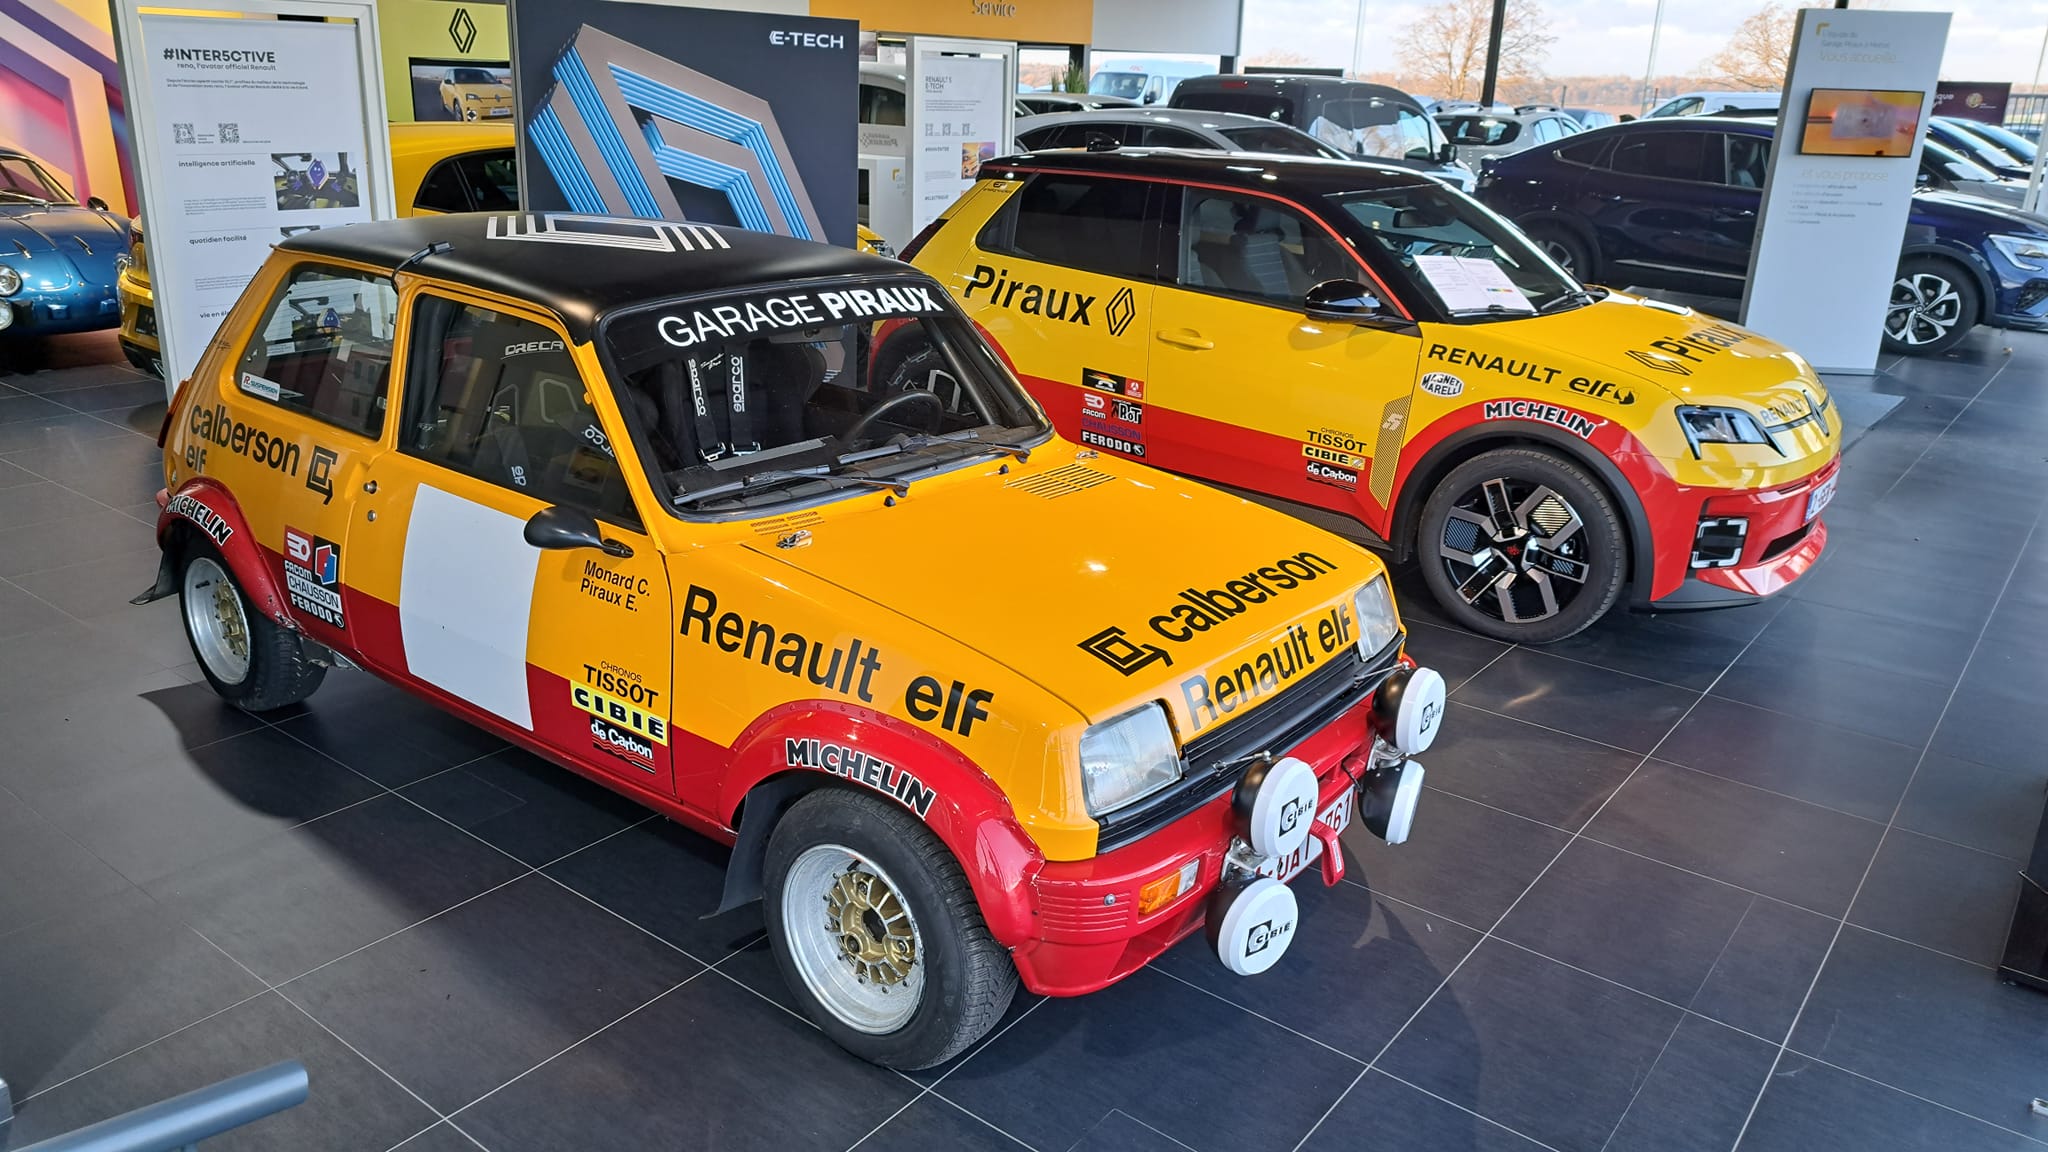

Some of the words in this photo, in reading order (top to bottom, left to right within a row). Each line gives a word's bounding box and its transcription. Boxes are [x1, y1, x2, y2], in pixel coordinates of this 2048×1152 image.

[973, 0, 1016, 17] Service
[163, 48, 276, 63] #INTER5CTIVE
[769, 29, 844, 49] E-TECH
[178, 160, 220, 168] intelligence
[189, 237, 222, 245] quotidien
[963, 264, 1097, 326] Piraux
[657, 295, 825, 347] GARAGE
[817, 287, 944, 320] PIRAUX
[1649, 324, 1752, 362] Piraux
[688, 358, 706, 417] sparco
[730, 355, 745, 412] sparco
[1427, 343, 1561, 384] RENAULT
[1568, 375, 1616, 398] elf
[1082, 418, 1142, 439] CHAUSSON
[1484, 401, 1596, 440] MICHELIN
[1760, 398, 1804, 425] RENAULT
[190, 403, 301, 477] calberson
[1082, 431, 1131, 453] FERODO
[1306, 430, 1368, 453] TISSOT
[1320, 427, 1354, 439] CHRONOS
[186, 444, 207, 473] elf
[1321, 466, 1357, 483] Carbon
[166, 494, 234, 546] MICHELIN
[288, 575, 339, 609] CHAUSSON
[580, 578, 622, 607] Piraux
[625, 593, 639, 613] E.
[583, 559, 635, 592] Monard
[636, 578, 650, 598] C.
[290, 592, 333, 623] FERODO
[1148, 551, 1339, 643] calberson
[600, 660, 642, 683] CHRONOS
[679, 584, 883, 704] Renault
[904, 674, 995, 738] elf
[1180, 622, 1316, 732] Renault
[1318, 602, 1353, 652] elf
[583, 663, 659, 709] TISSOT
[591, 718, 607, 740] de
[608, 728, 653, 760] Carbon
[784, 738, 938, 822] MICHELIN
